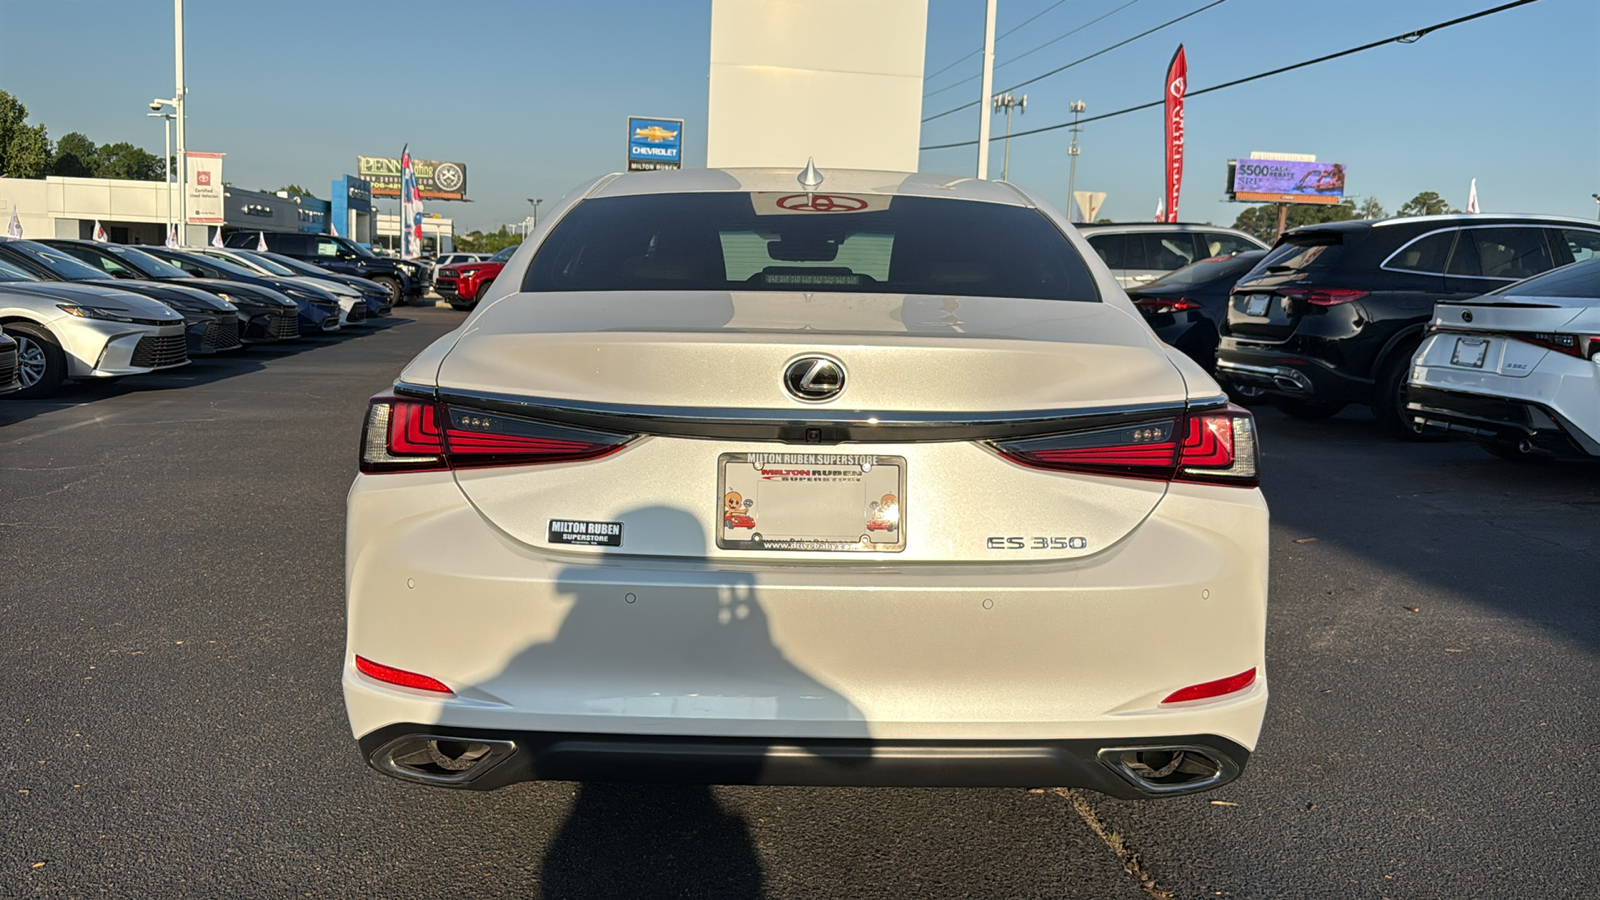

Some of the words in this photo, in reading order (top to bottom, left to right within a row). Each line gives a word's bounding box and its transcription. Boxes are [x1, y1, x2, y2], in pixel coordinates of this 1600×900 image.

[632, 147, 677, 156] CHEVROLET
[1239, 164, 1269, 177] $500
[747, 453, 782, 464] MILTON
[783, 454, 816, 464] RUBEN
[817, 455, 878, 465] SUPERSTORE
[552, 521, 586, 533] MILTON
[588, 523, 619, 535] RUBEN
[986, 536, 1025, 549] ES
[1030, 536, 1087, 549] 350
